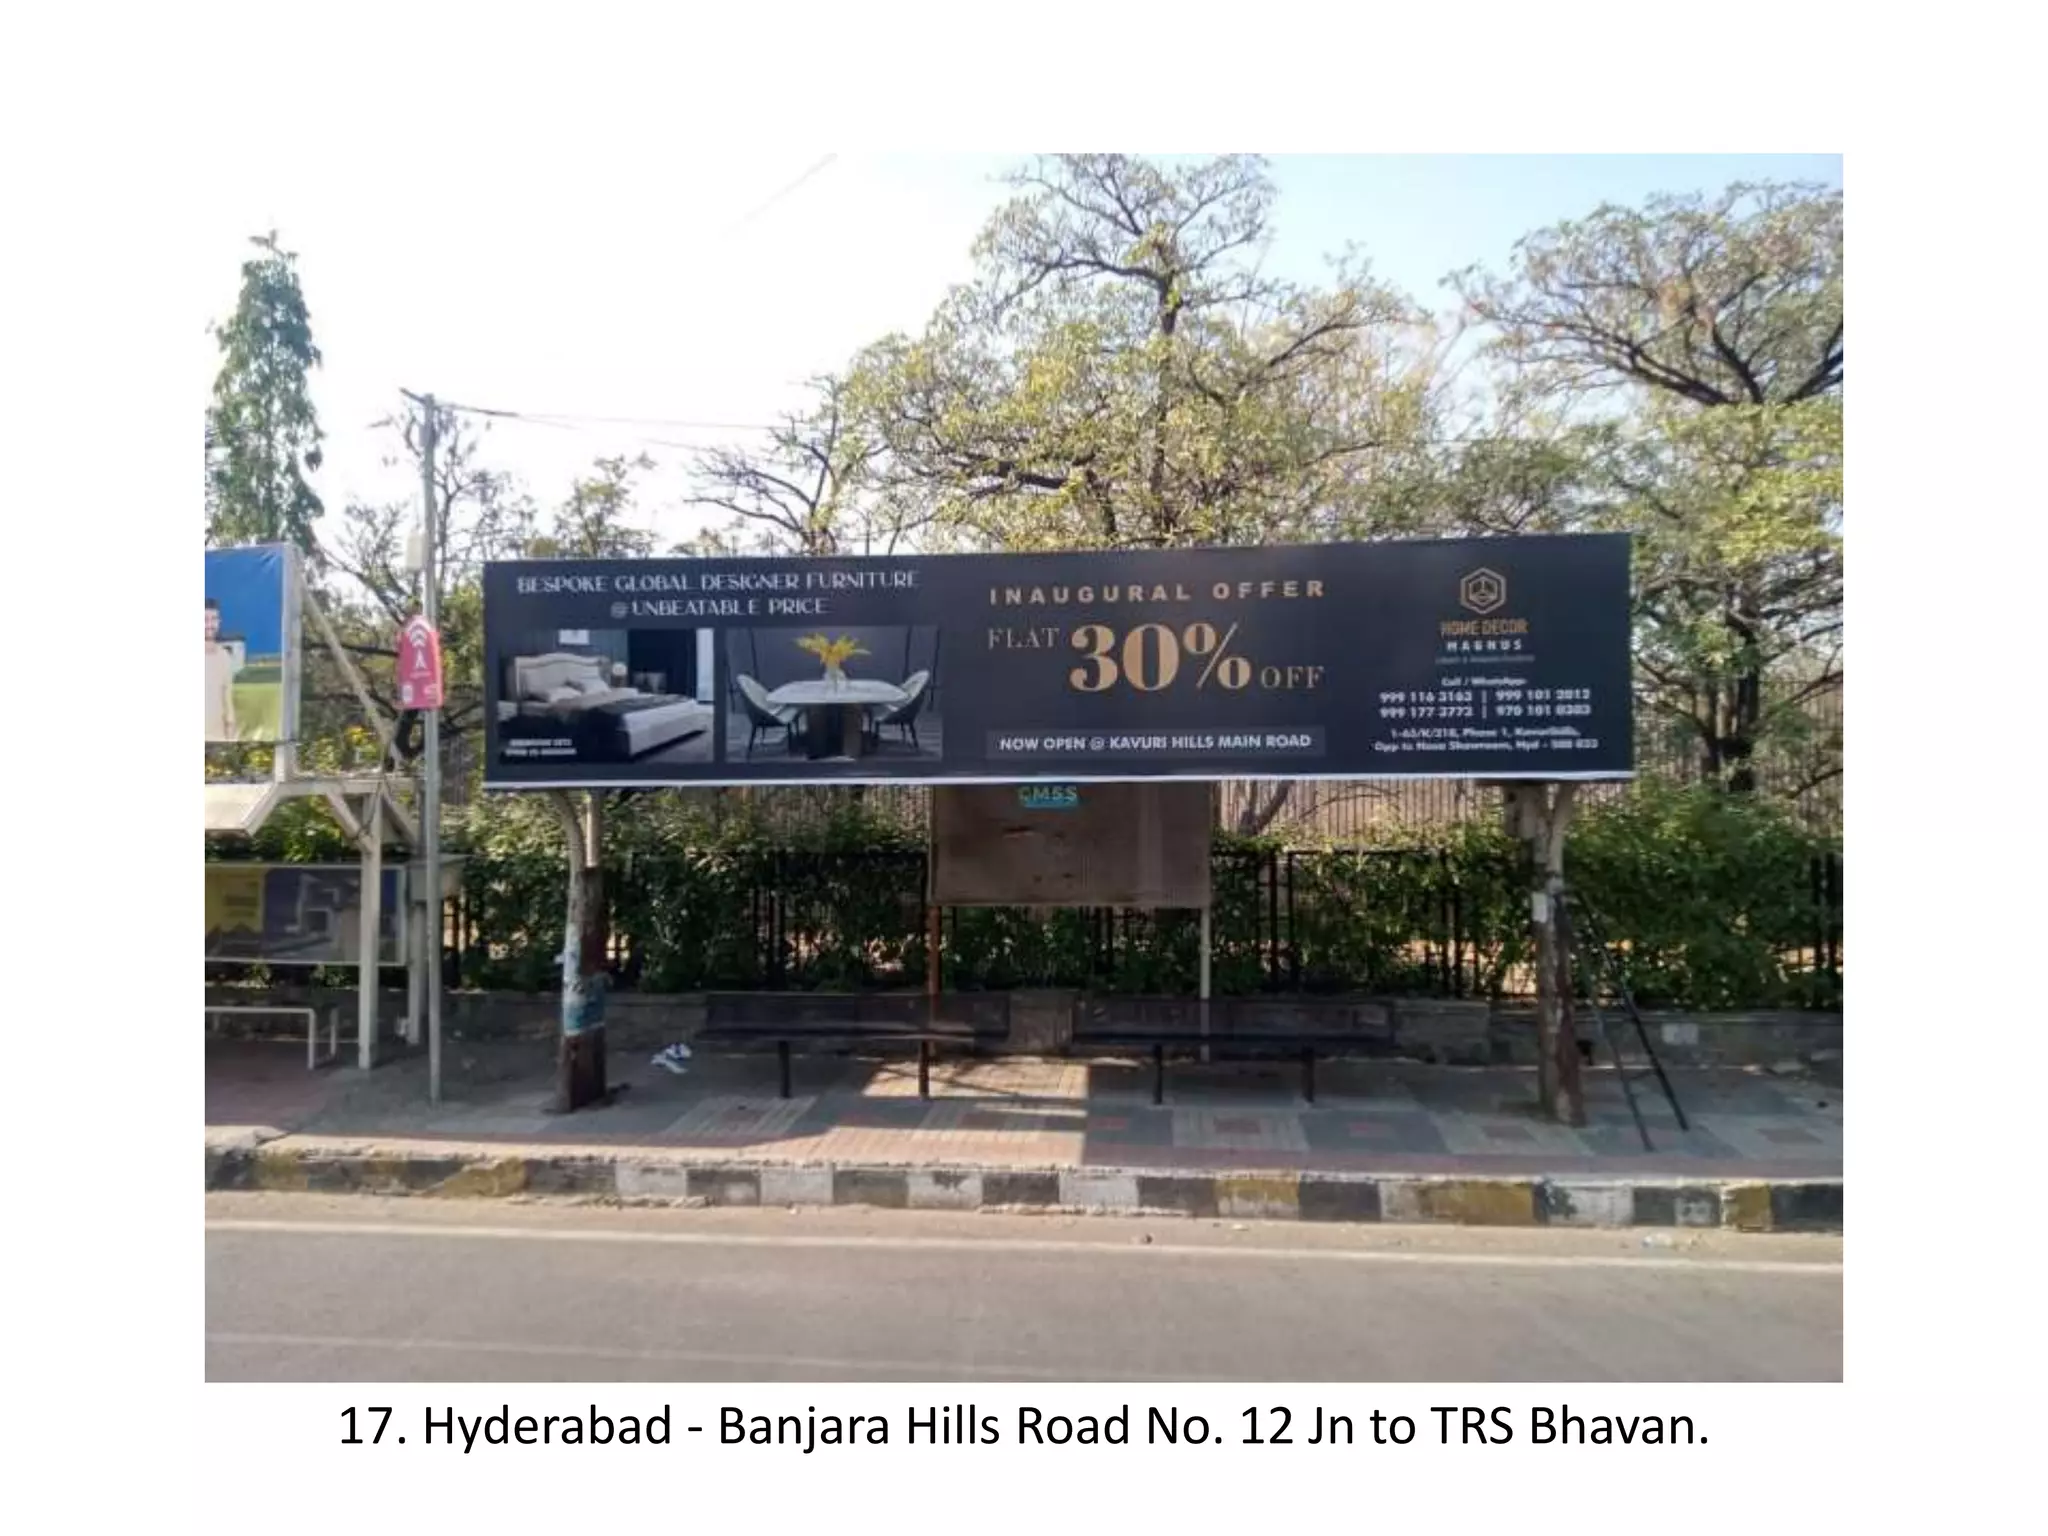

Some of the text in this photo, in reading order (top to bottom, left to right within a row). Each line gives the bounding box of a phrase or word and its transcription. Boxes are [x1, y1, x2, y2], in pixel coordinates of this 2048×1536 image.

[517, 570, 920, 594] BESPOKE GLOBAL DESIGNER FURNITURE
[990, 580, 1325, 606] INAUGURAL OFFER
[632, 598, 761, 618] UNBEATABLE
[768, 597, 829, 615] PRICE
[1441, 617, 1529, 636] HOME DECOR
[1446, 639, 1523, 651] MAGNUS
[987, 621, 1325, 692] FLAT 30% OFF
[1379, 691, 1405, 703] 999
[1495, 689, 1522, 701] 999
[1379, 706, 1406, 718] 999
[1000, 734, 1313, 750] NOW OPEN @ KAVURI HILLS MAIN ROAD
